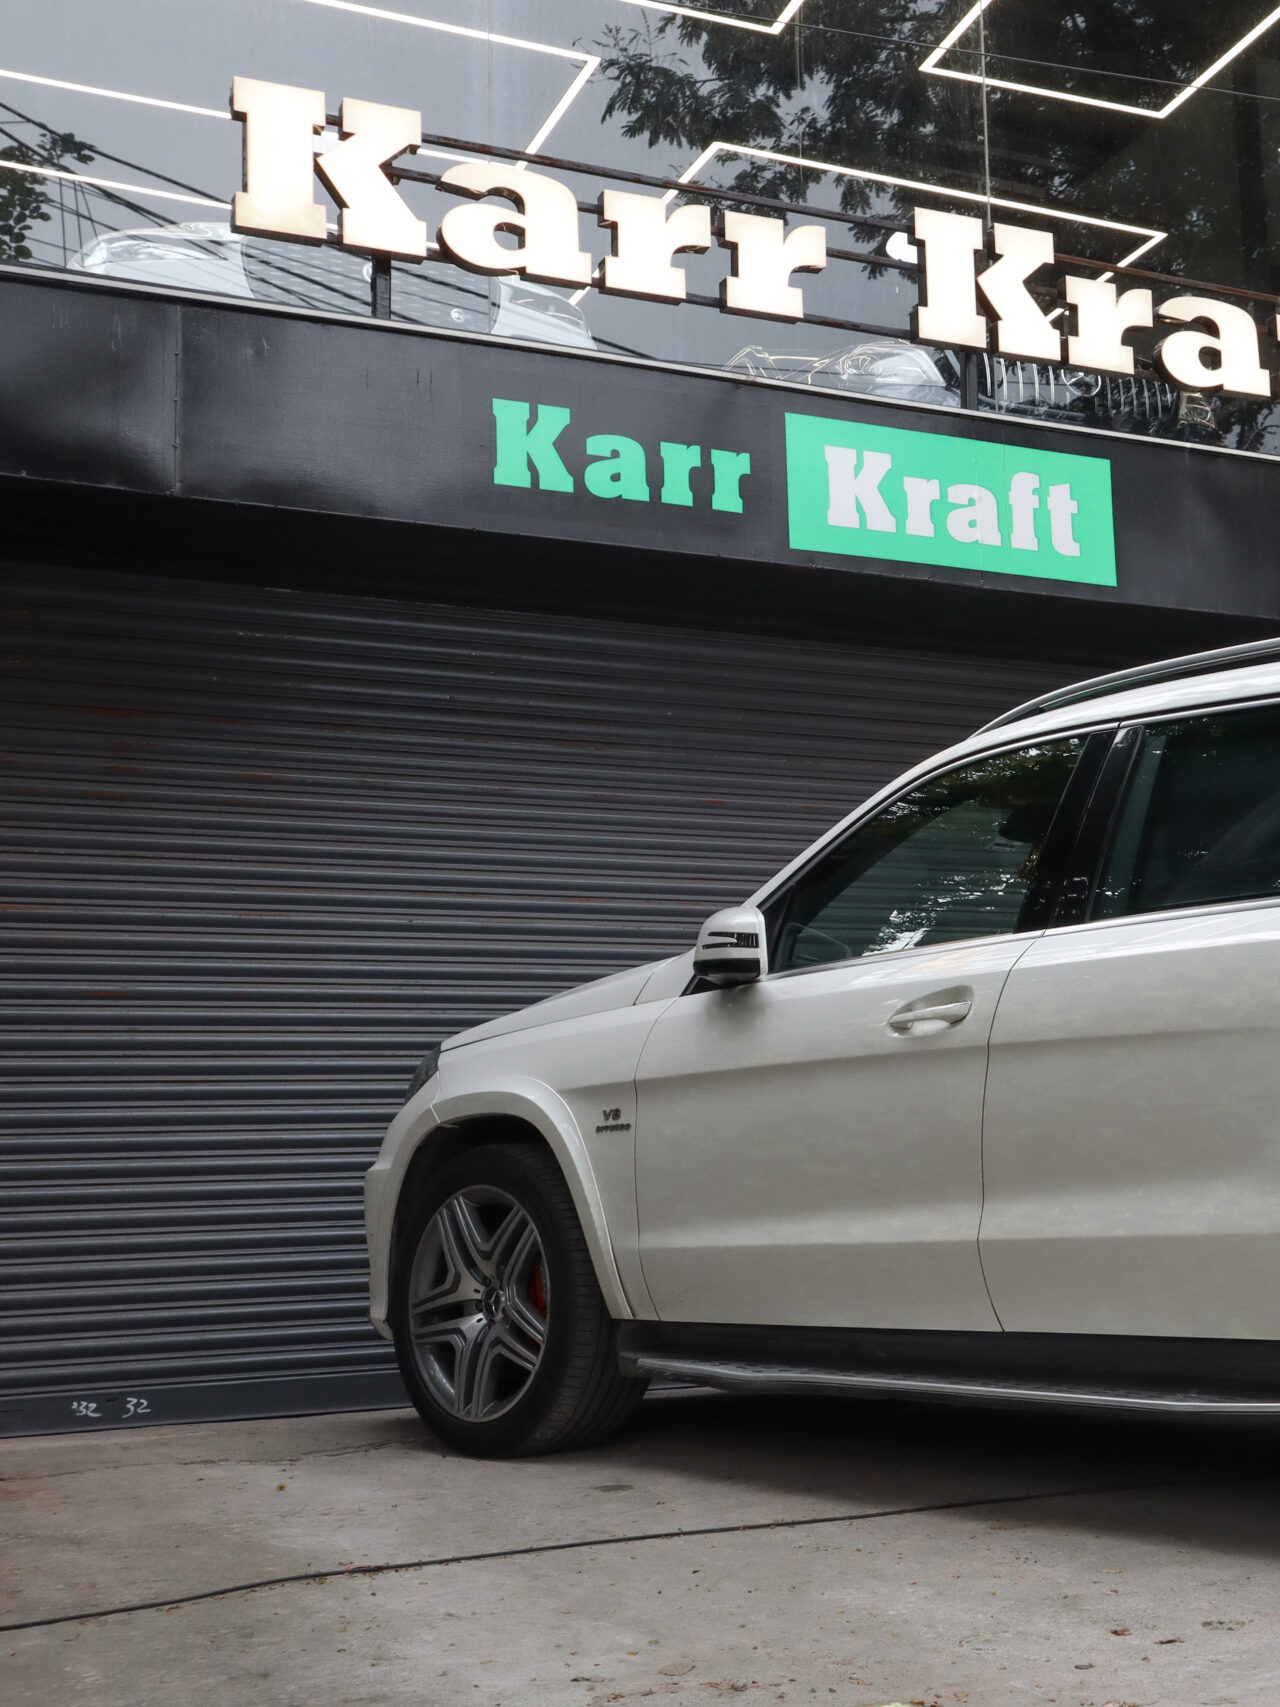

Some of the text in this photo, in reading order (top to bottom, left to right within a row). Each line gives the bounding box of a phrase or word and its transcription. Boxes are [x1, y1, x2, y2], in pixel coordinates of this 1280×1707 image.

[232, 76, 826, 322] Karr
[491, 398, 1081, 558] Karr Kraft
[602, 1108, 622, 1121] V8
[121, 1397, 151, 1418] 32
